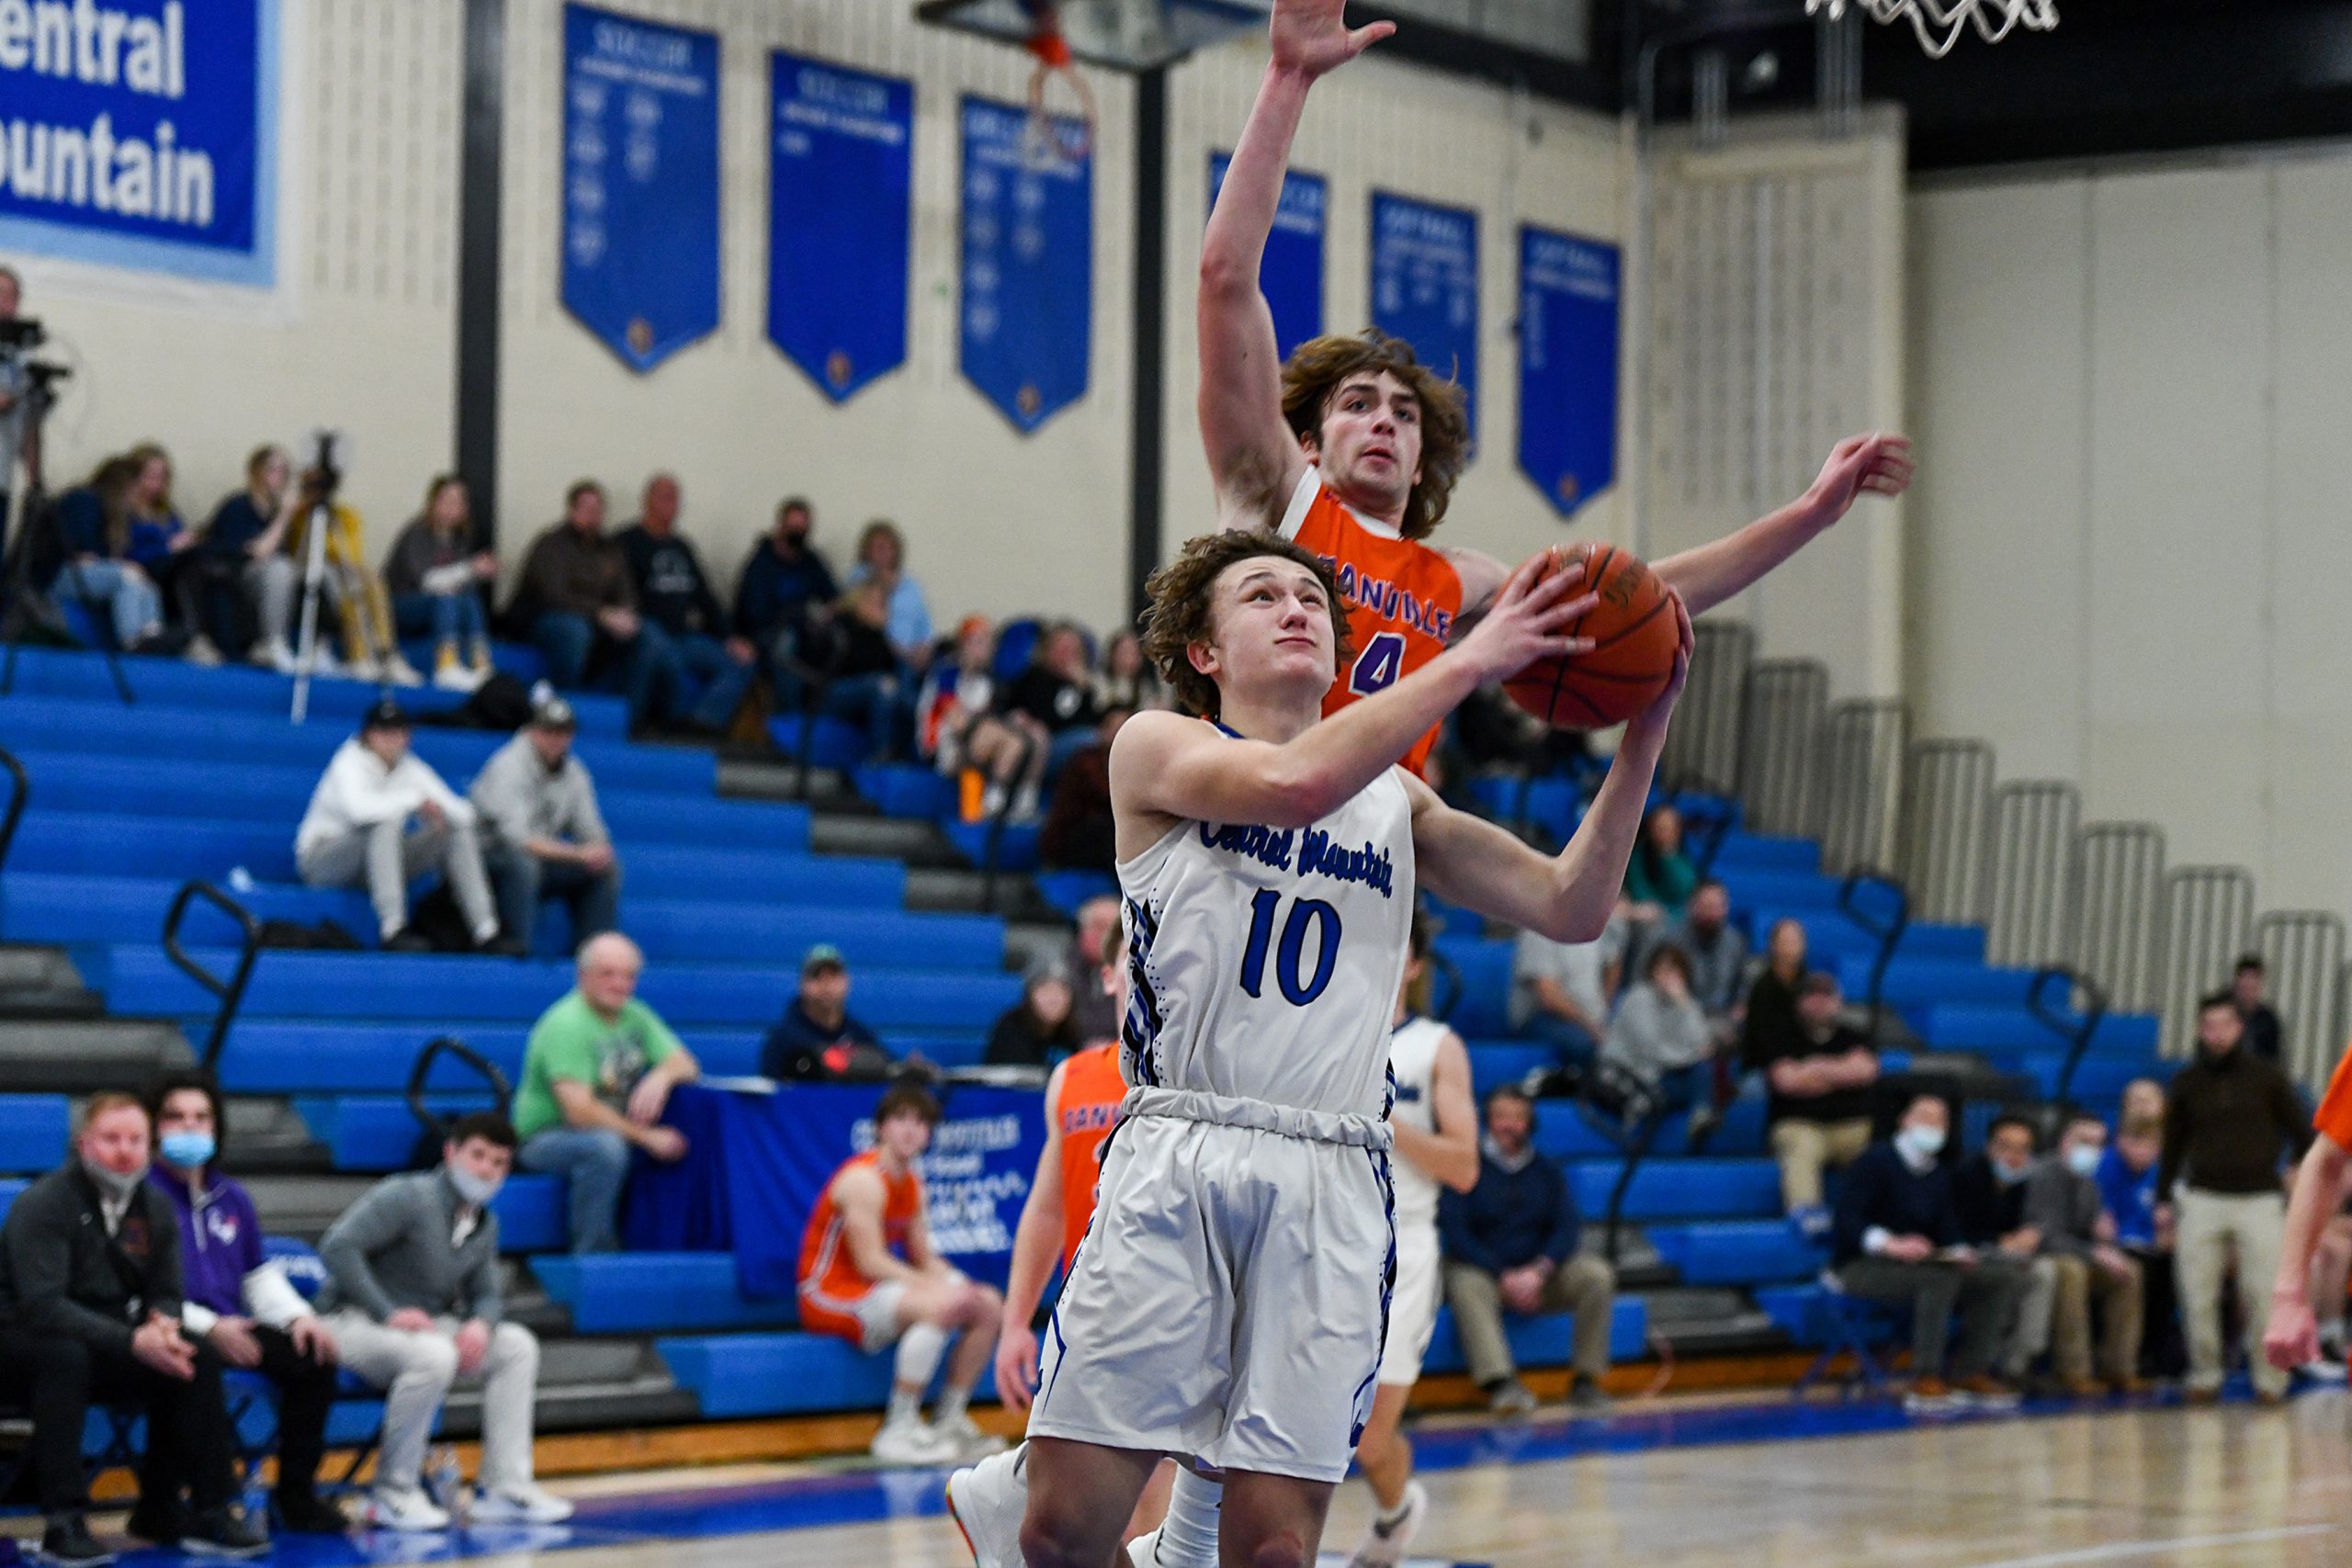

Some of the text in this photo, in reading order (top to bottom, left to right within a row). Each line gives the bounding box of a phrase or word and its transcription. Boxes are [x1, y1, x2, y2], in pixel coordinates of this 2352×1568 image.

[0, 111, 215, 227] untain
[1348, 631, 1408, 698] 4
[1239, 886, 1342, 1008] 10
